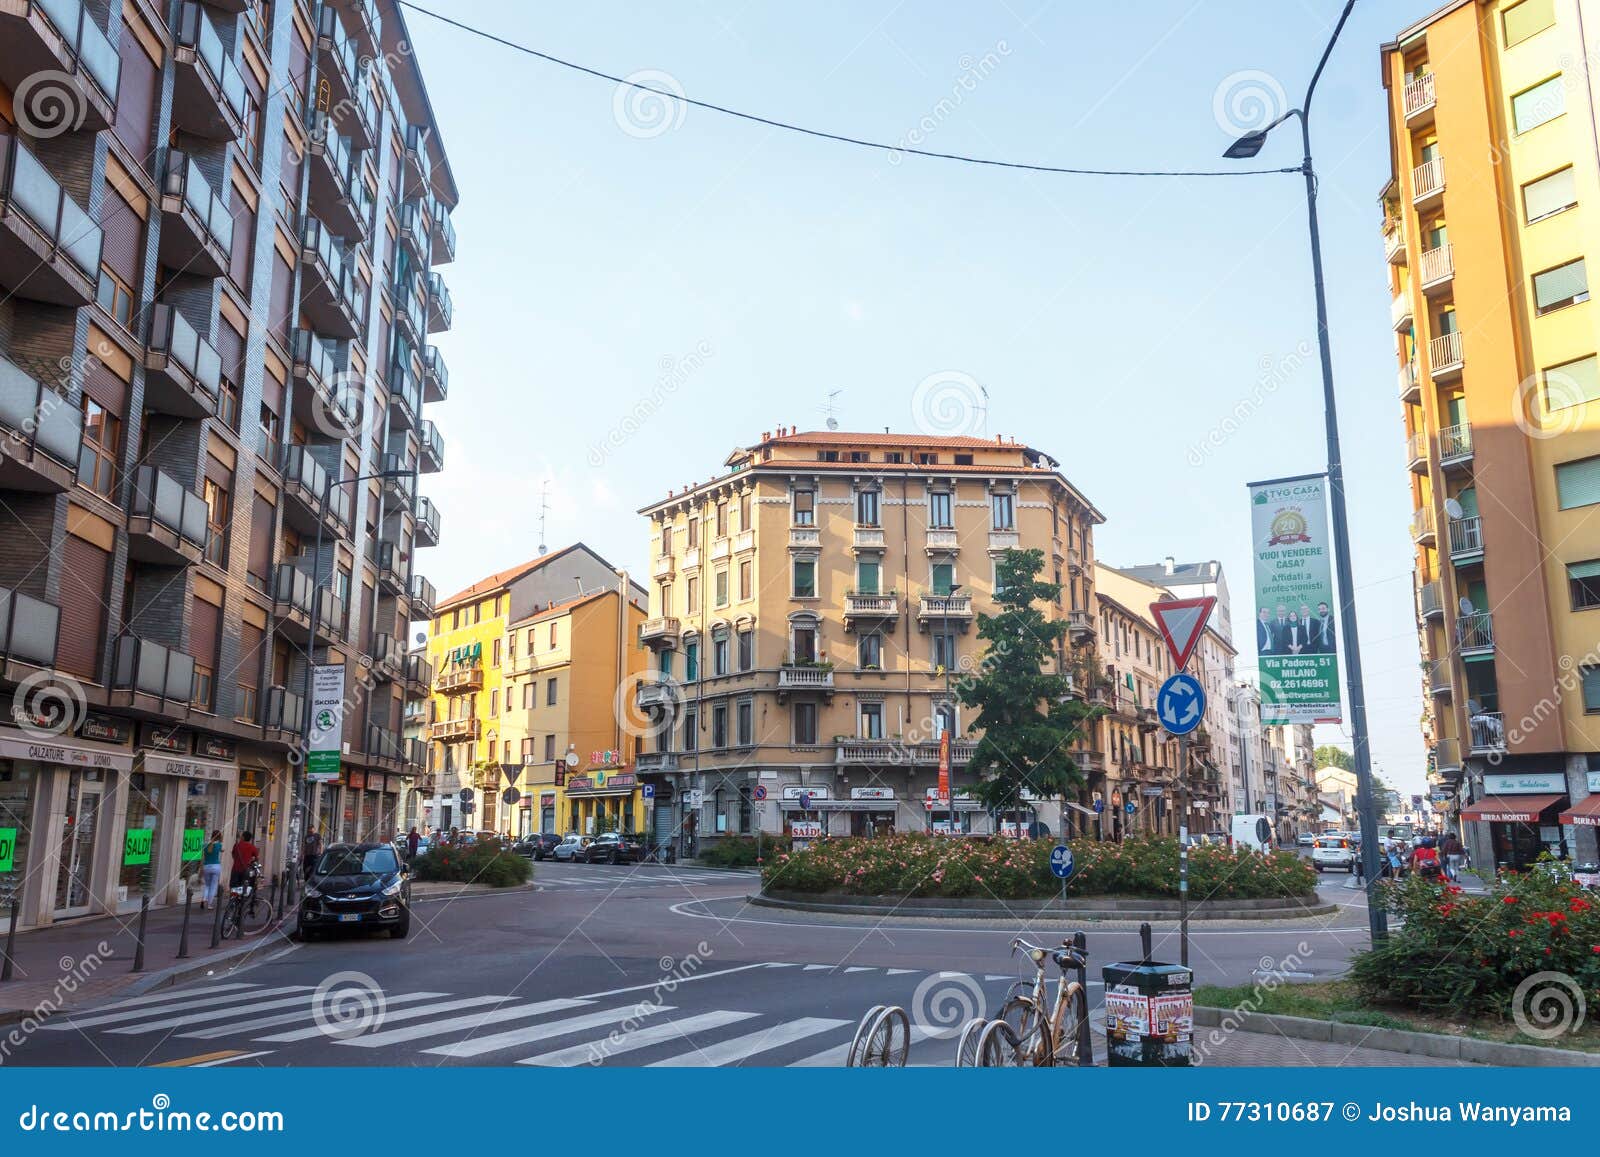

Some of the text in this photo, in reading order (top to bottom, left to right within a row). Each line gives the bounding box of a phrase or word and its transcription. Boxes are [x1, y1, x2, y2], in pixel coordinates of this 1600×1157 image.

[1269, 486, 1320, 498] TVG CASA
[1280, 520, 1296, 531] 20
[1259, 547, 1323, 561] VUOI VENDERE
[1276, 558, 1305, 569] CASA?
[1271, 572, 1304, 582] Affidati
[1262, 582, 1323, 594] professionisti
[1265, 657, 1331, 668] Via Padova, 51
[1281, 668, 1317, 678] MILANO
[1270, 679, 1329, 689] 02.26146961
[29, 746, 65, 761] CALZATURE
[94, 755, 111, 766] UOMO
[644, 785, 653, 796] P
[1480, 813, 1531, 822] BIRRA MORETTI
[1573, 816, 1597, 825] BIRRA
[126, 837, 150, 857] SALDI
